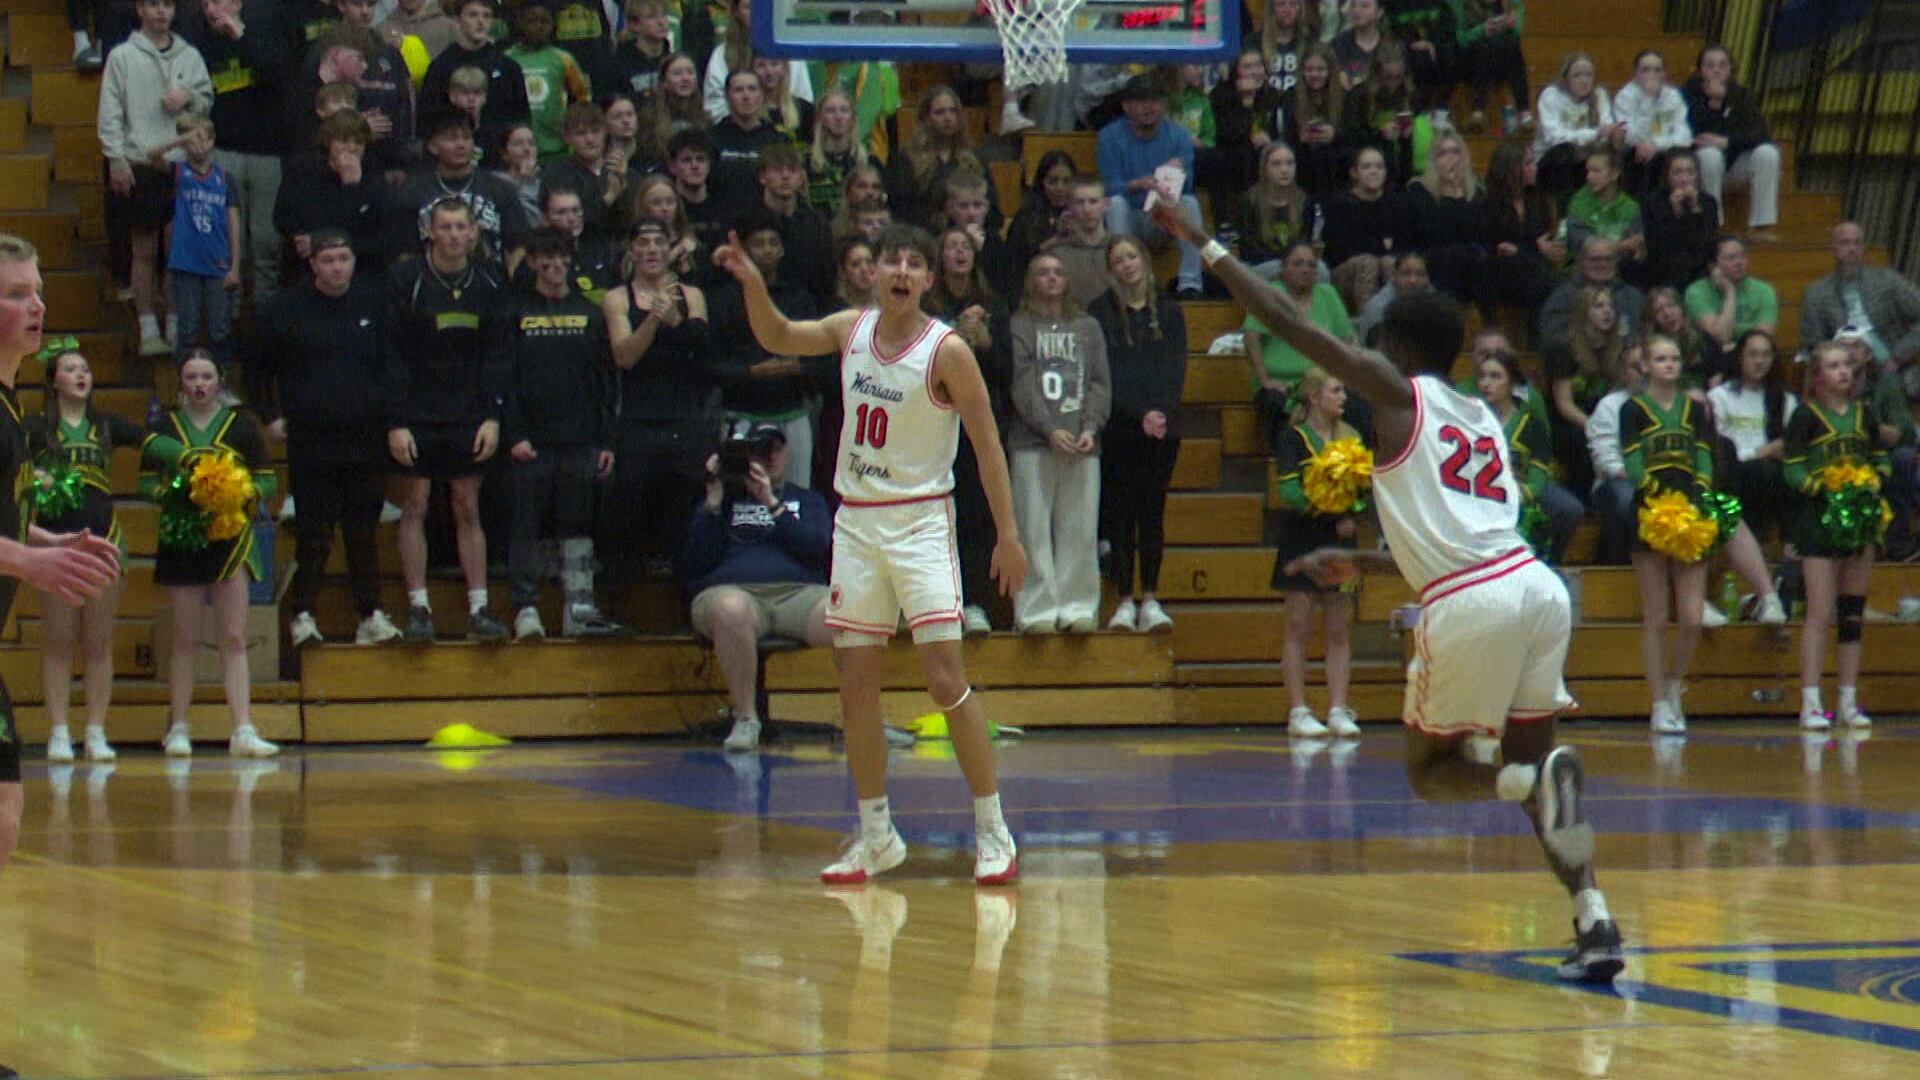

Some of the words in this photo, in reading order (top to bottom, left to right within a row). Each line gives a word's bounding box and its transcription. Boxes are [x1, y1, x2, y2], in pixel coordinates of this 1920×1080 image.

[1036, 331, 1077, 362] NIKE
[850, 371, 904, 402] Warsaw
[854, 403, 889, 450] 10
[848, 451, 893, 481] Tigers
[1438, 424, 1508, 504] 22
[1192, 568, 1208, 593] C
